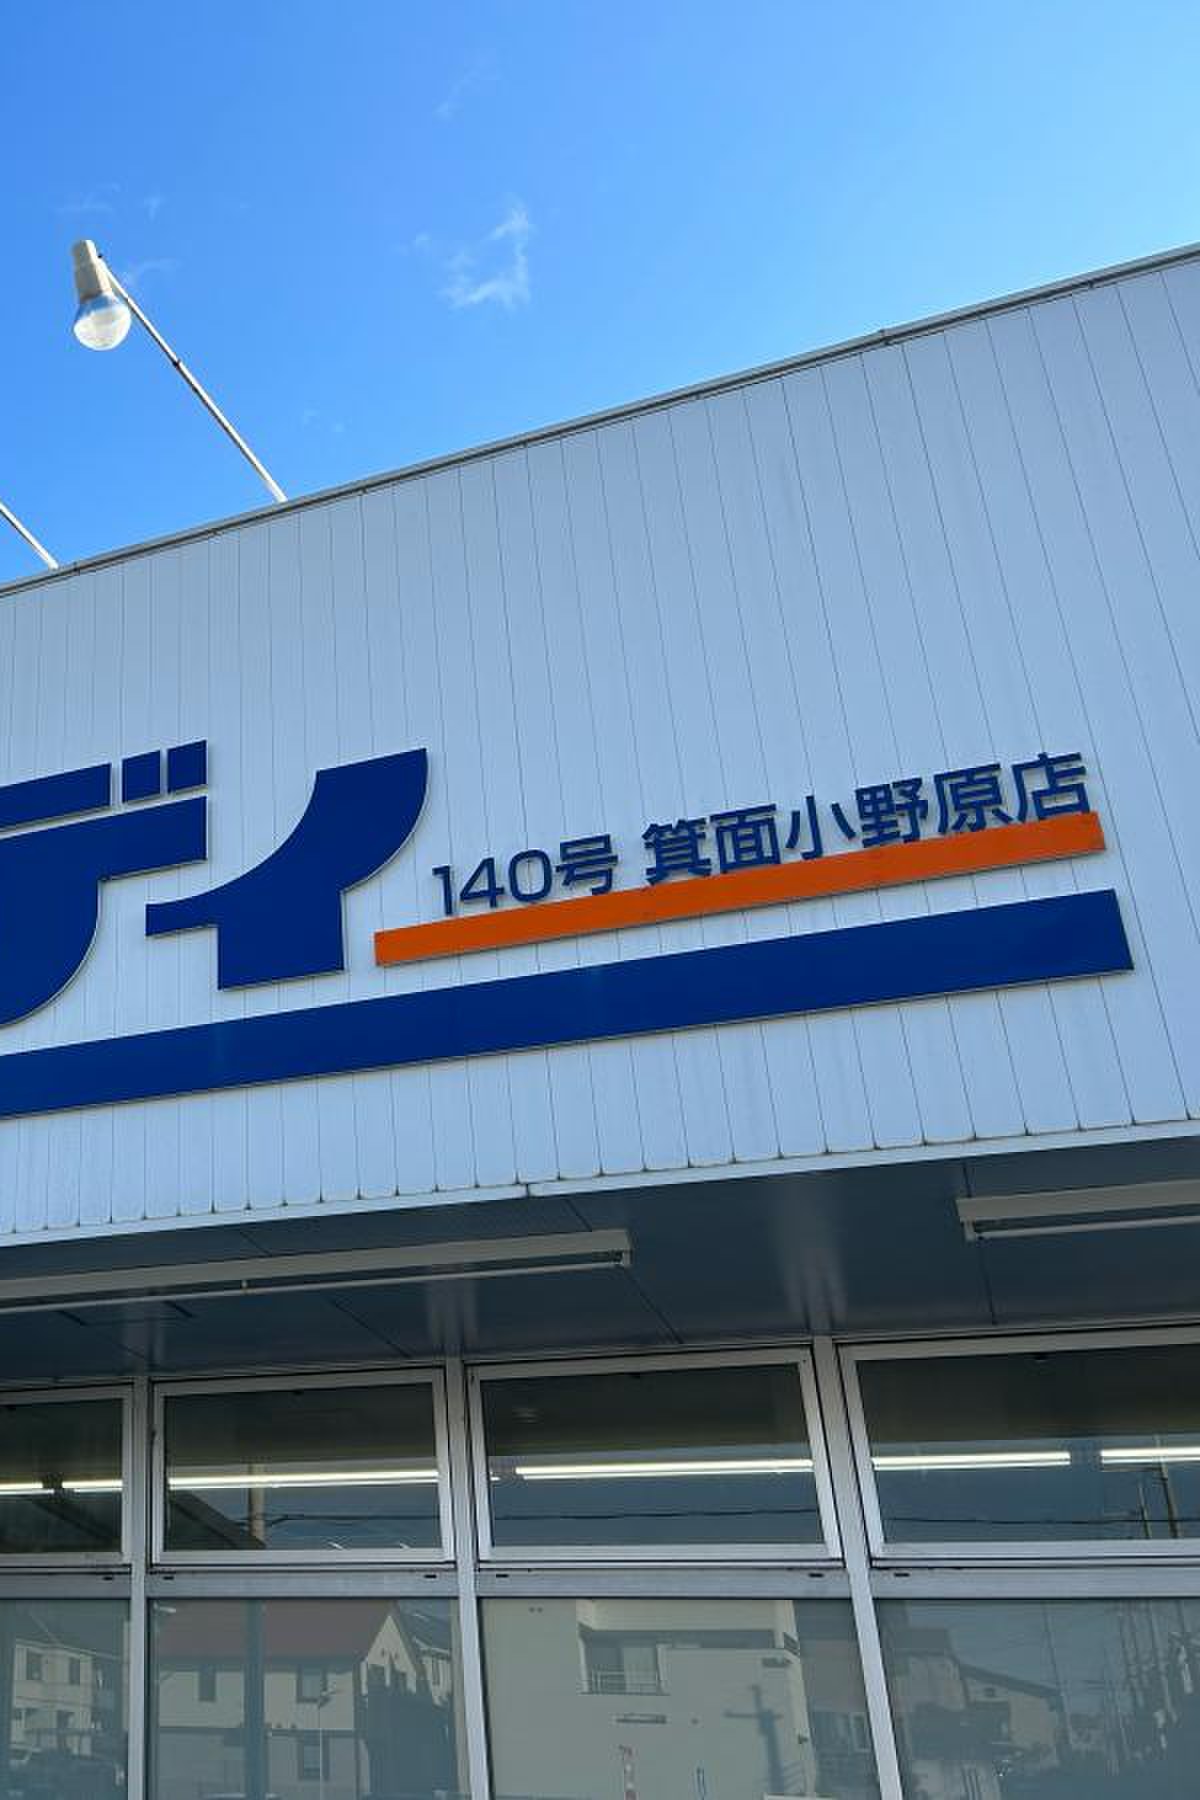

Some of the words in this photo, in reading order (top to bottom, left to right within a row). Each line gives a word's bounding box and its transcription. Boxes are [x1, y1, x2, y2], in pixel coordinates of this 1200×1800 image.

[432, 834, 618, 915] 140号
[642, 752, 1091, 885] 箕面小野原店
